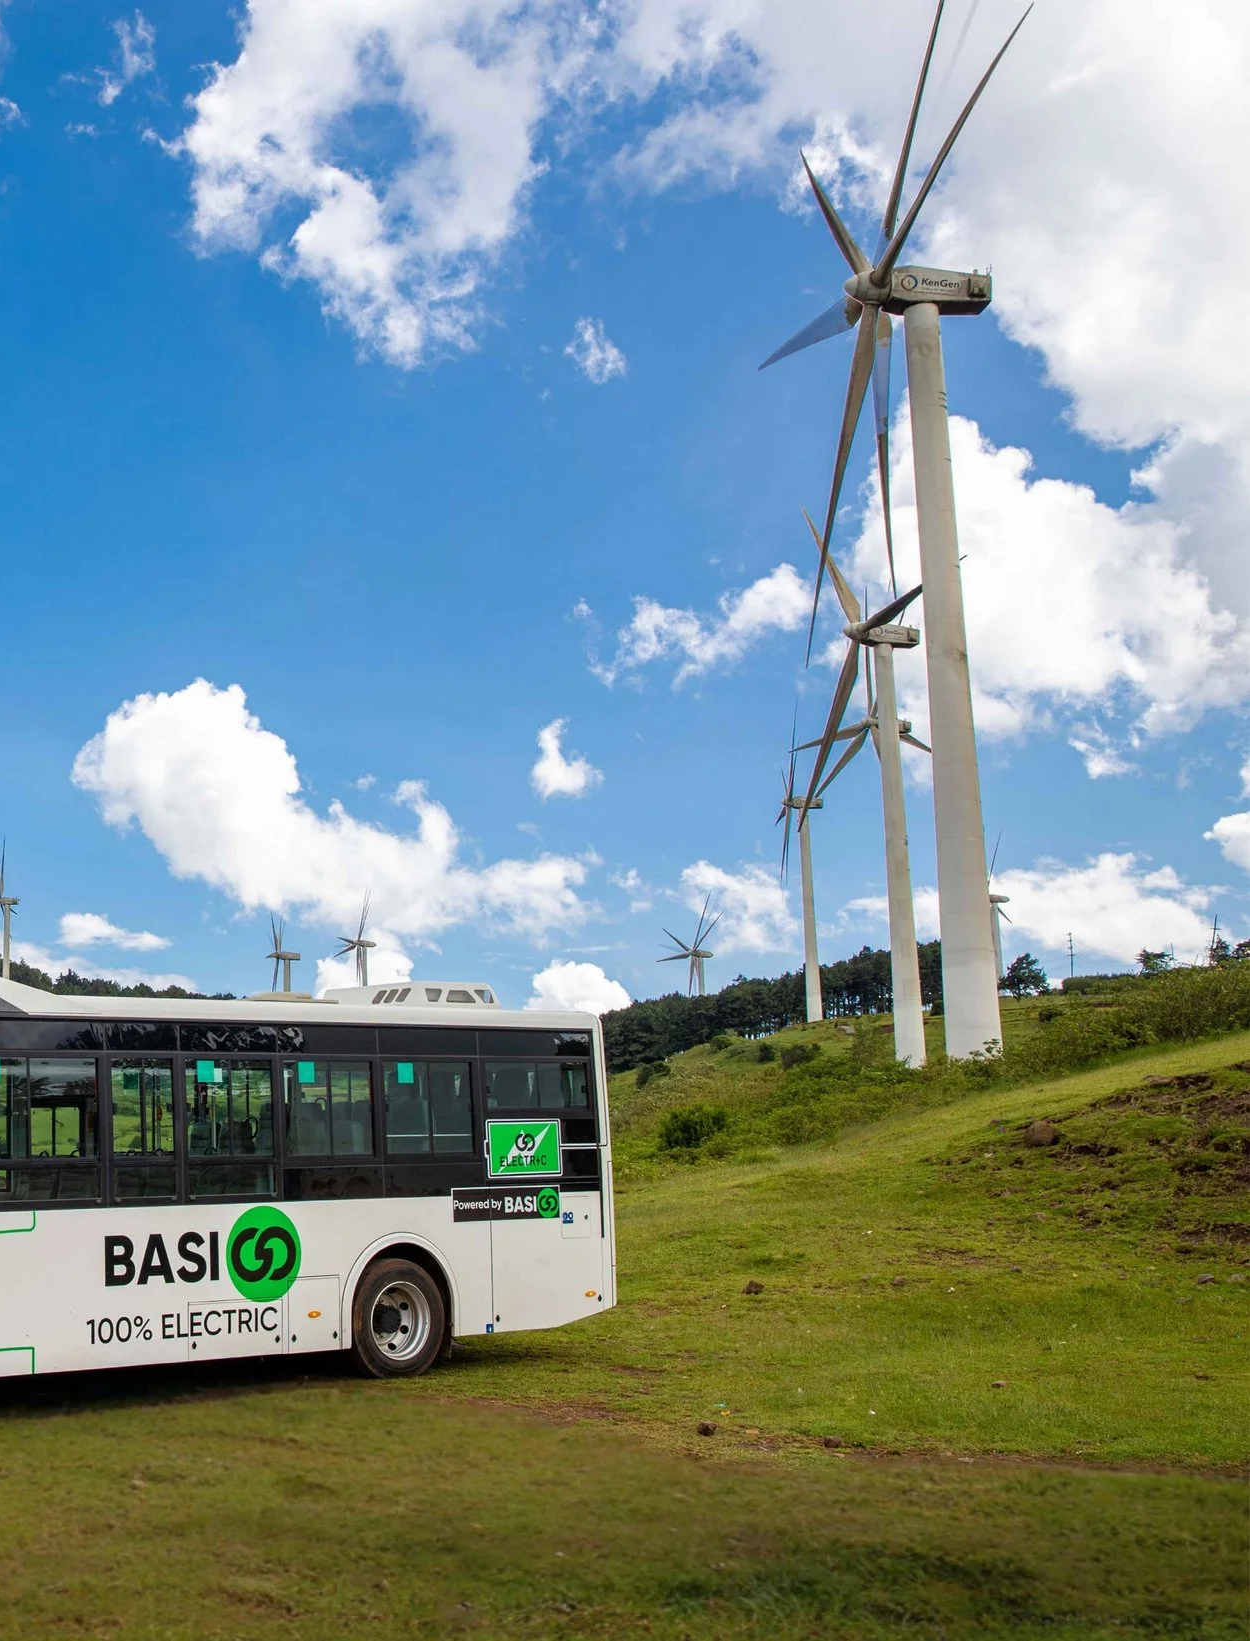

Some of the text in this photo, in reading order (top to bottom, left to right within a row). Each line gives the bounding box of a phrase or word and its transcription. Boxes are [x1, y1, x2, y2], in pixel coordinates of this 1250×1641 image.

[921, 277, 960, 289] KenGen
[499, 1155, 547, 1167] ELECTRIC
[453, 1199, 490, 1210] Powered
[491, 1198, 502, 1210] by
[86, 1306, 278, 1345] 100% ELECTRIC
